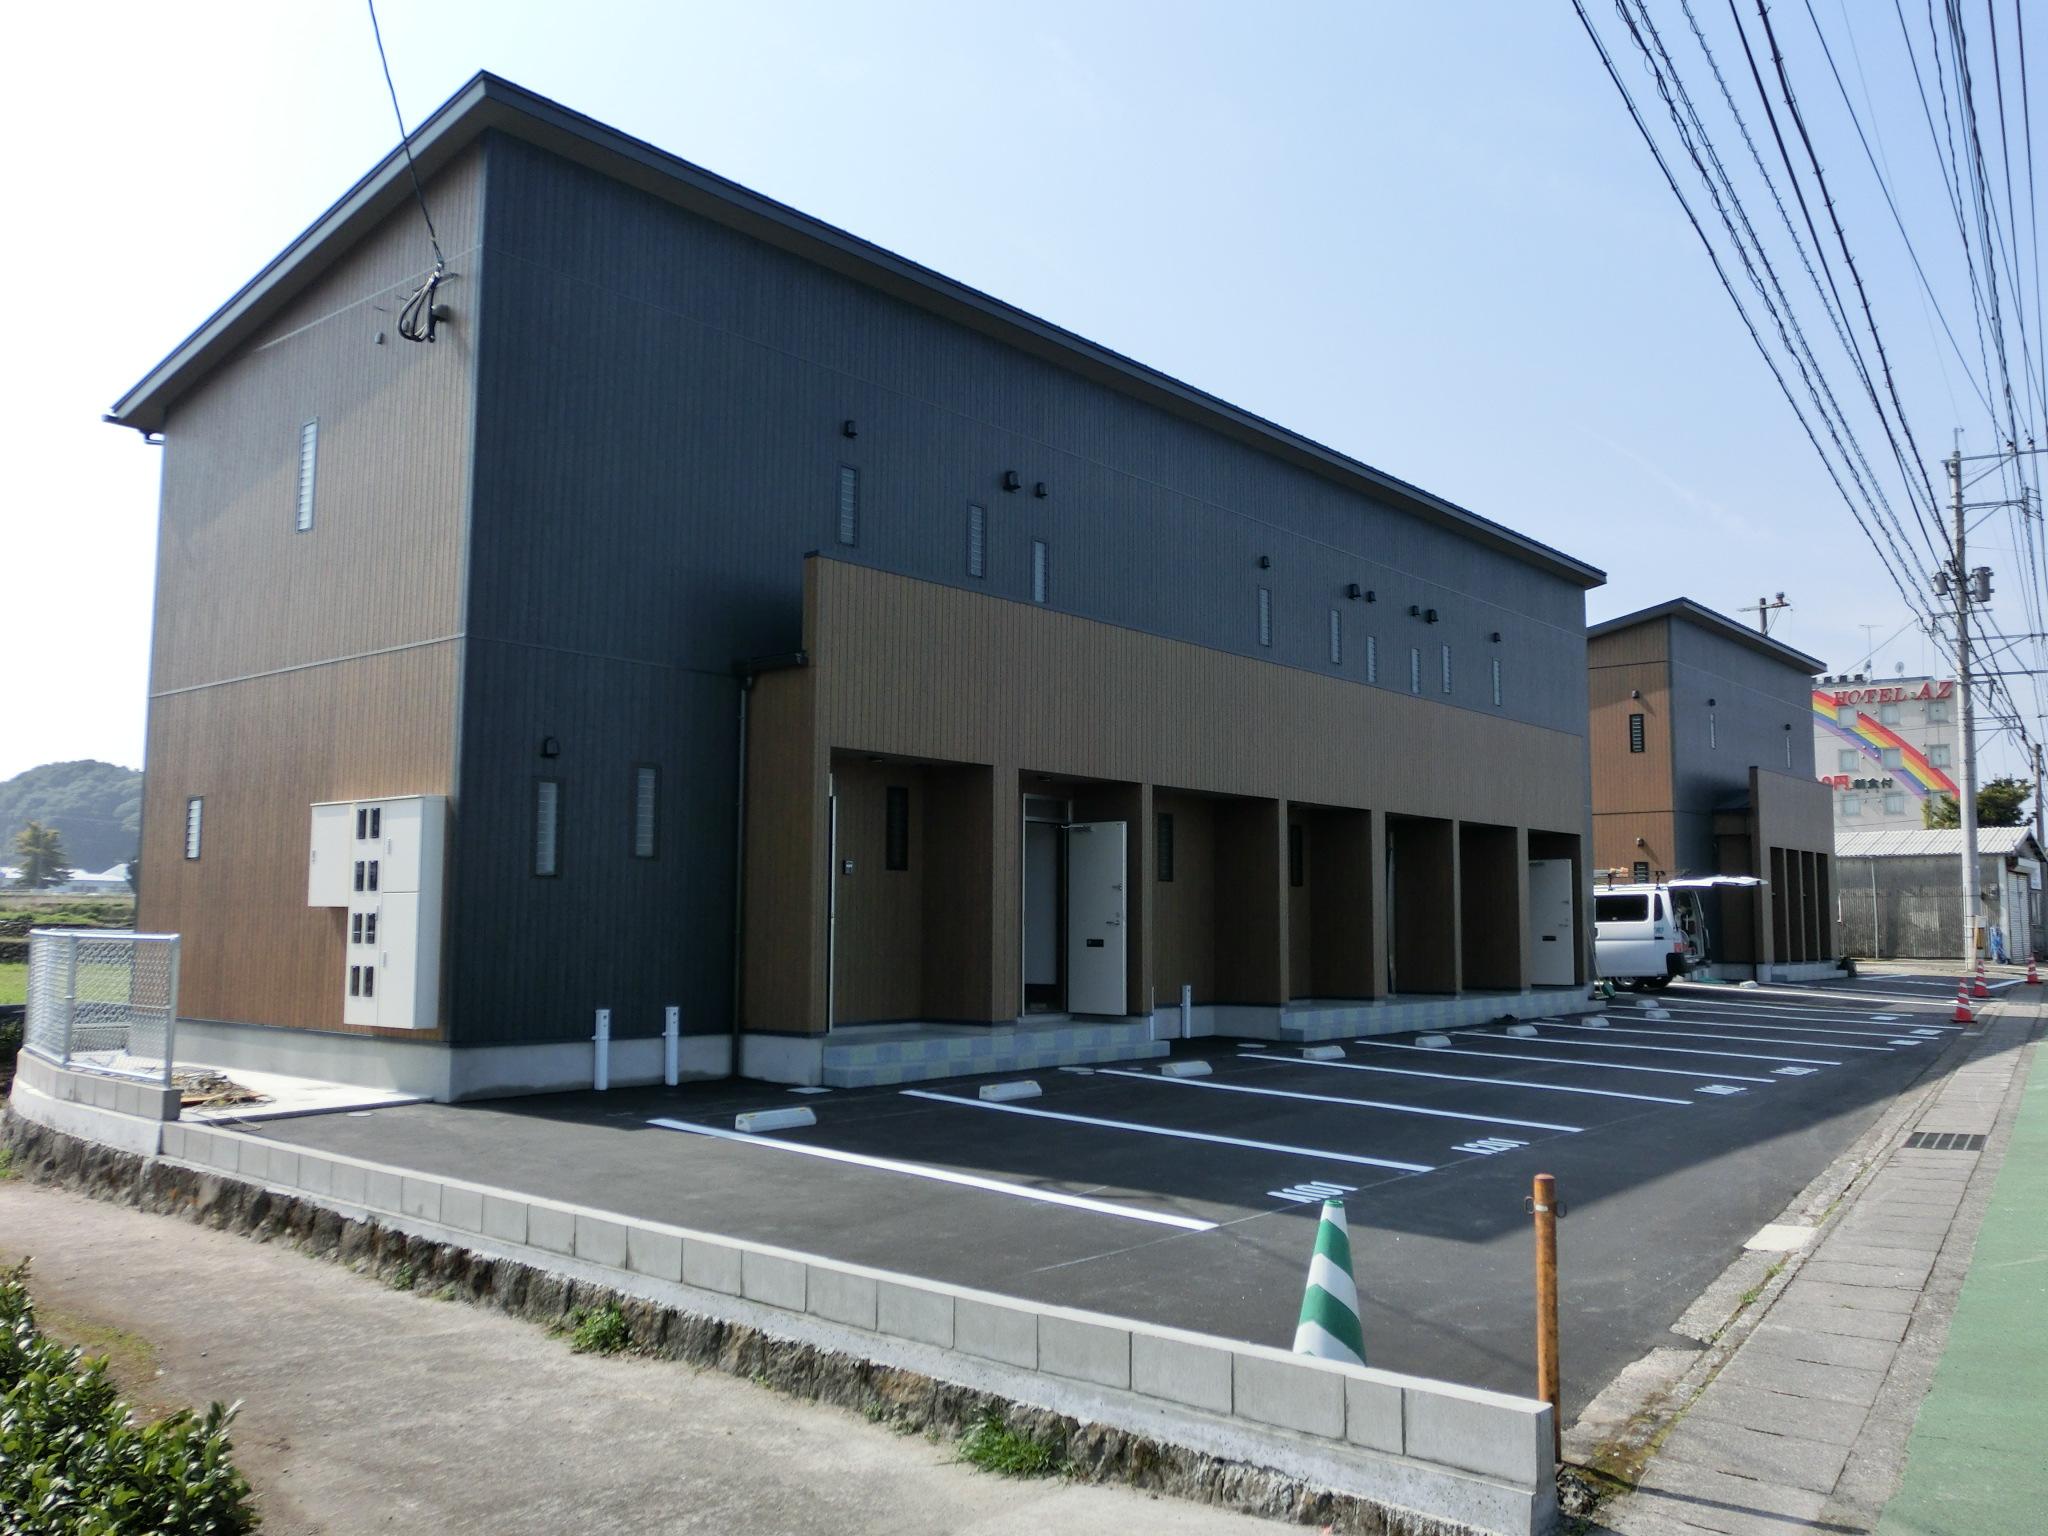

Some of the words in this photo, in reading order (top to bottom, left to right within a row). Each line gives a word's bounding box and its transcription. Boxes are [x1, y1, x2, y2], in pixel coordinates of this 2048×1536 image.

[1833, 687, 1907, 706] HOTEL
[1916, 681, 1954, 702] AZ
[1266, 1181, 1359, 1203] A101
